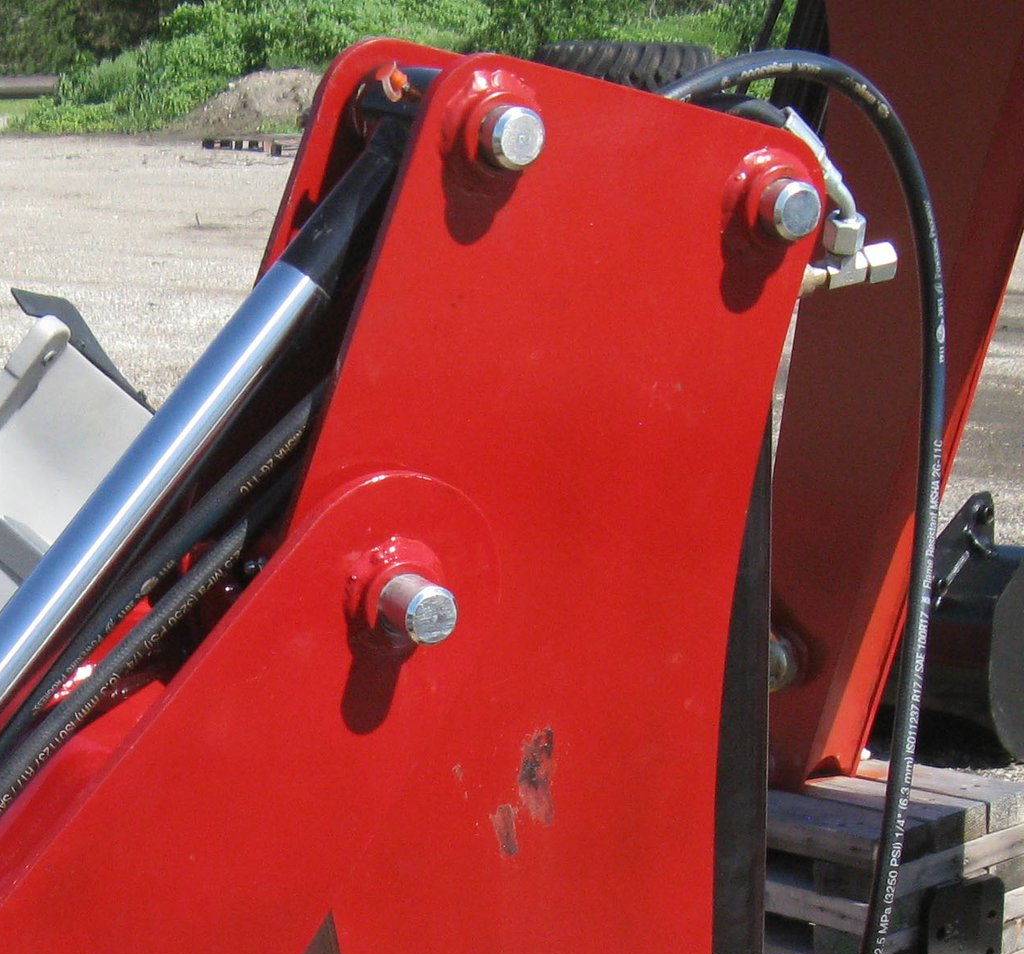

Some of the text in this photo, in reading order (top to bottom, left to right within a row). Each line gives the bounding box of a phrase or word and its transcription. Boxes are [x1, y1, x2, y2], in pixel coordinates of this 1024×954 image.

[932, 439, 943, 479] 2G-11C
[929, 480, 941, 510] MSHA
[925, 510, 938, 558] Resistant
[922, 559, 934, 590] Flame
[917, 612, 930, 649] 100R17
[914, 652, 926, 673] SAE
[911, 681, 923, 703] R17
[904, 757, 915, 785] mm)
[899, 786, 911, 810] (6.3
[895, 813, 906, 838] 1/4"
[890, 842, 903, 868] PSI)
[884, 870, 898, 905] (3250
[878, 907, 892, 935] MPa
